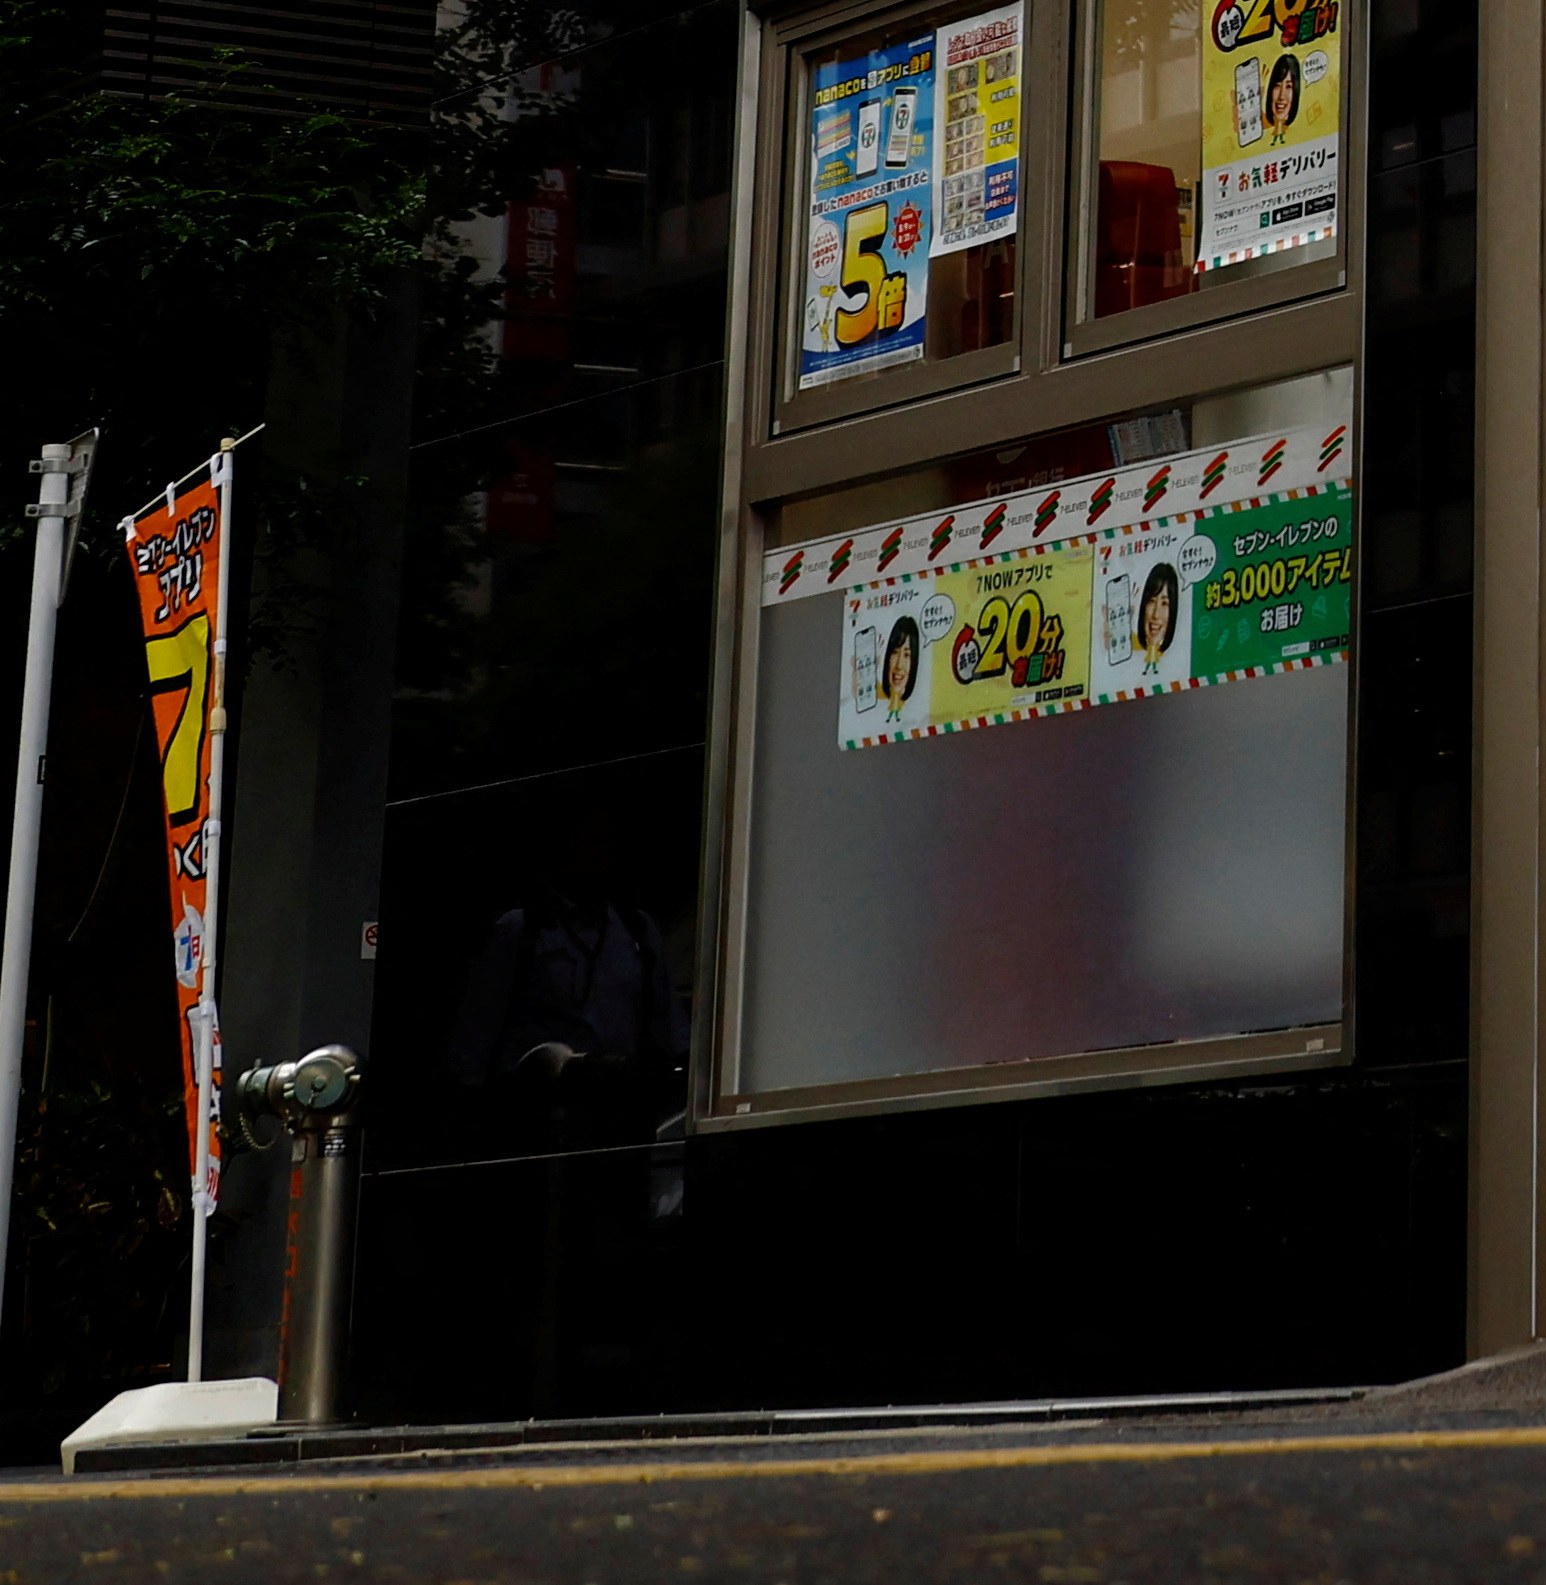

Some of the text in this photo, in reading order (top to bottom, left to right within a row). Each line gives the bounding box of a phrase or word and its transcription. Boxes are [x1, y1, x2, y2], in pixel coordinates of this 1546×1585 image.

[1238, 148, 1336, 192] お気軽デリバリー
[813, 256, 836, 269] ポイント
[976, 563, 1054, 594] 7NOWアプリで
[1260, 603, 1304, 633] お届け
